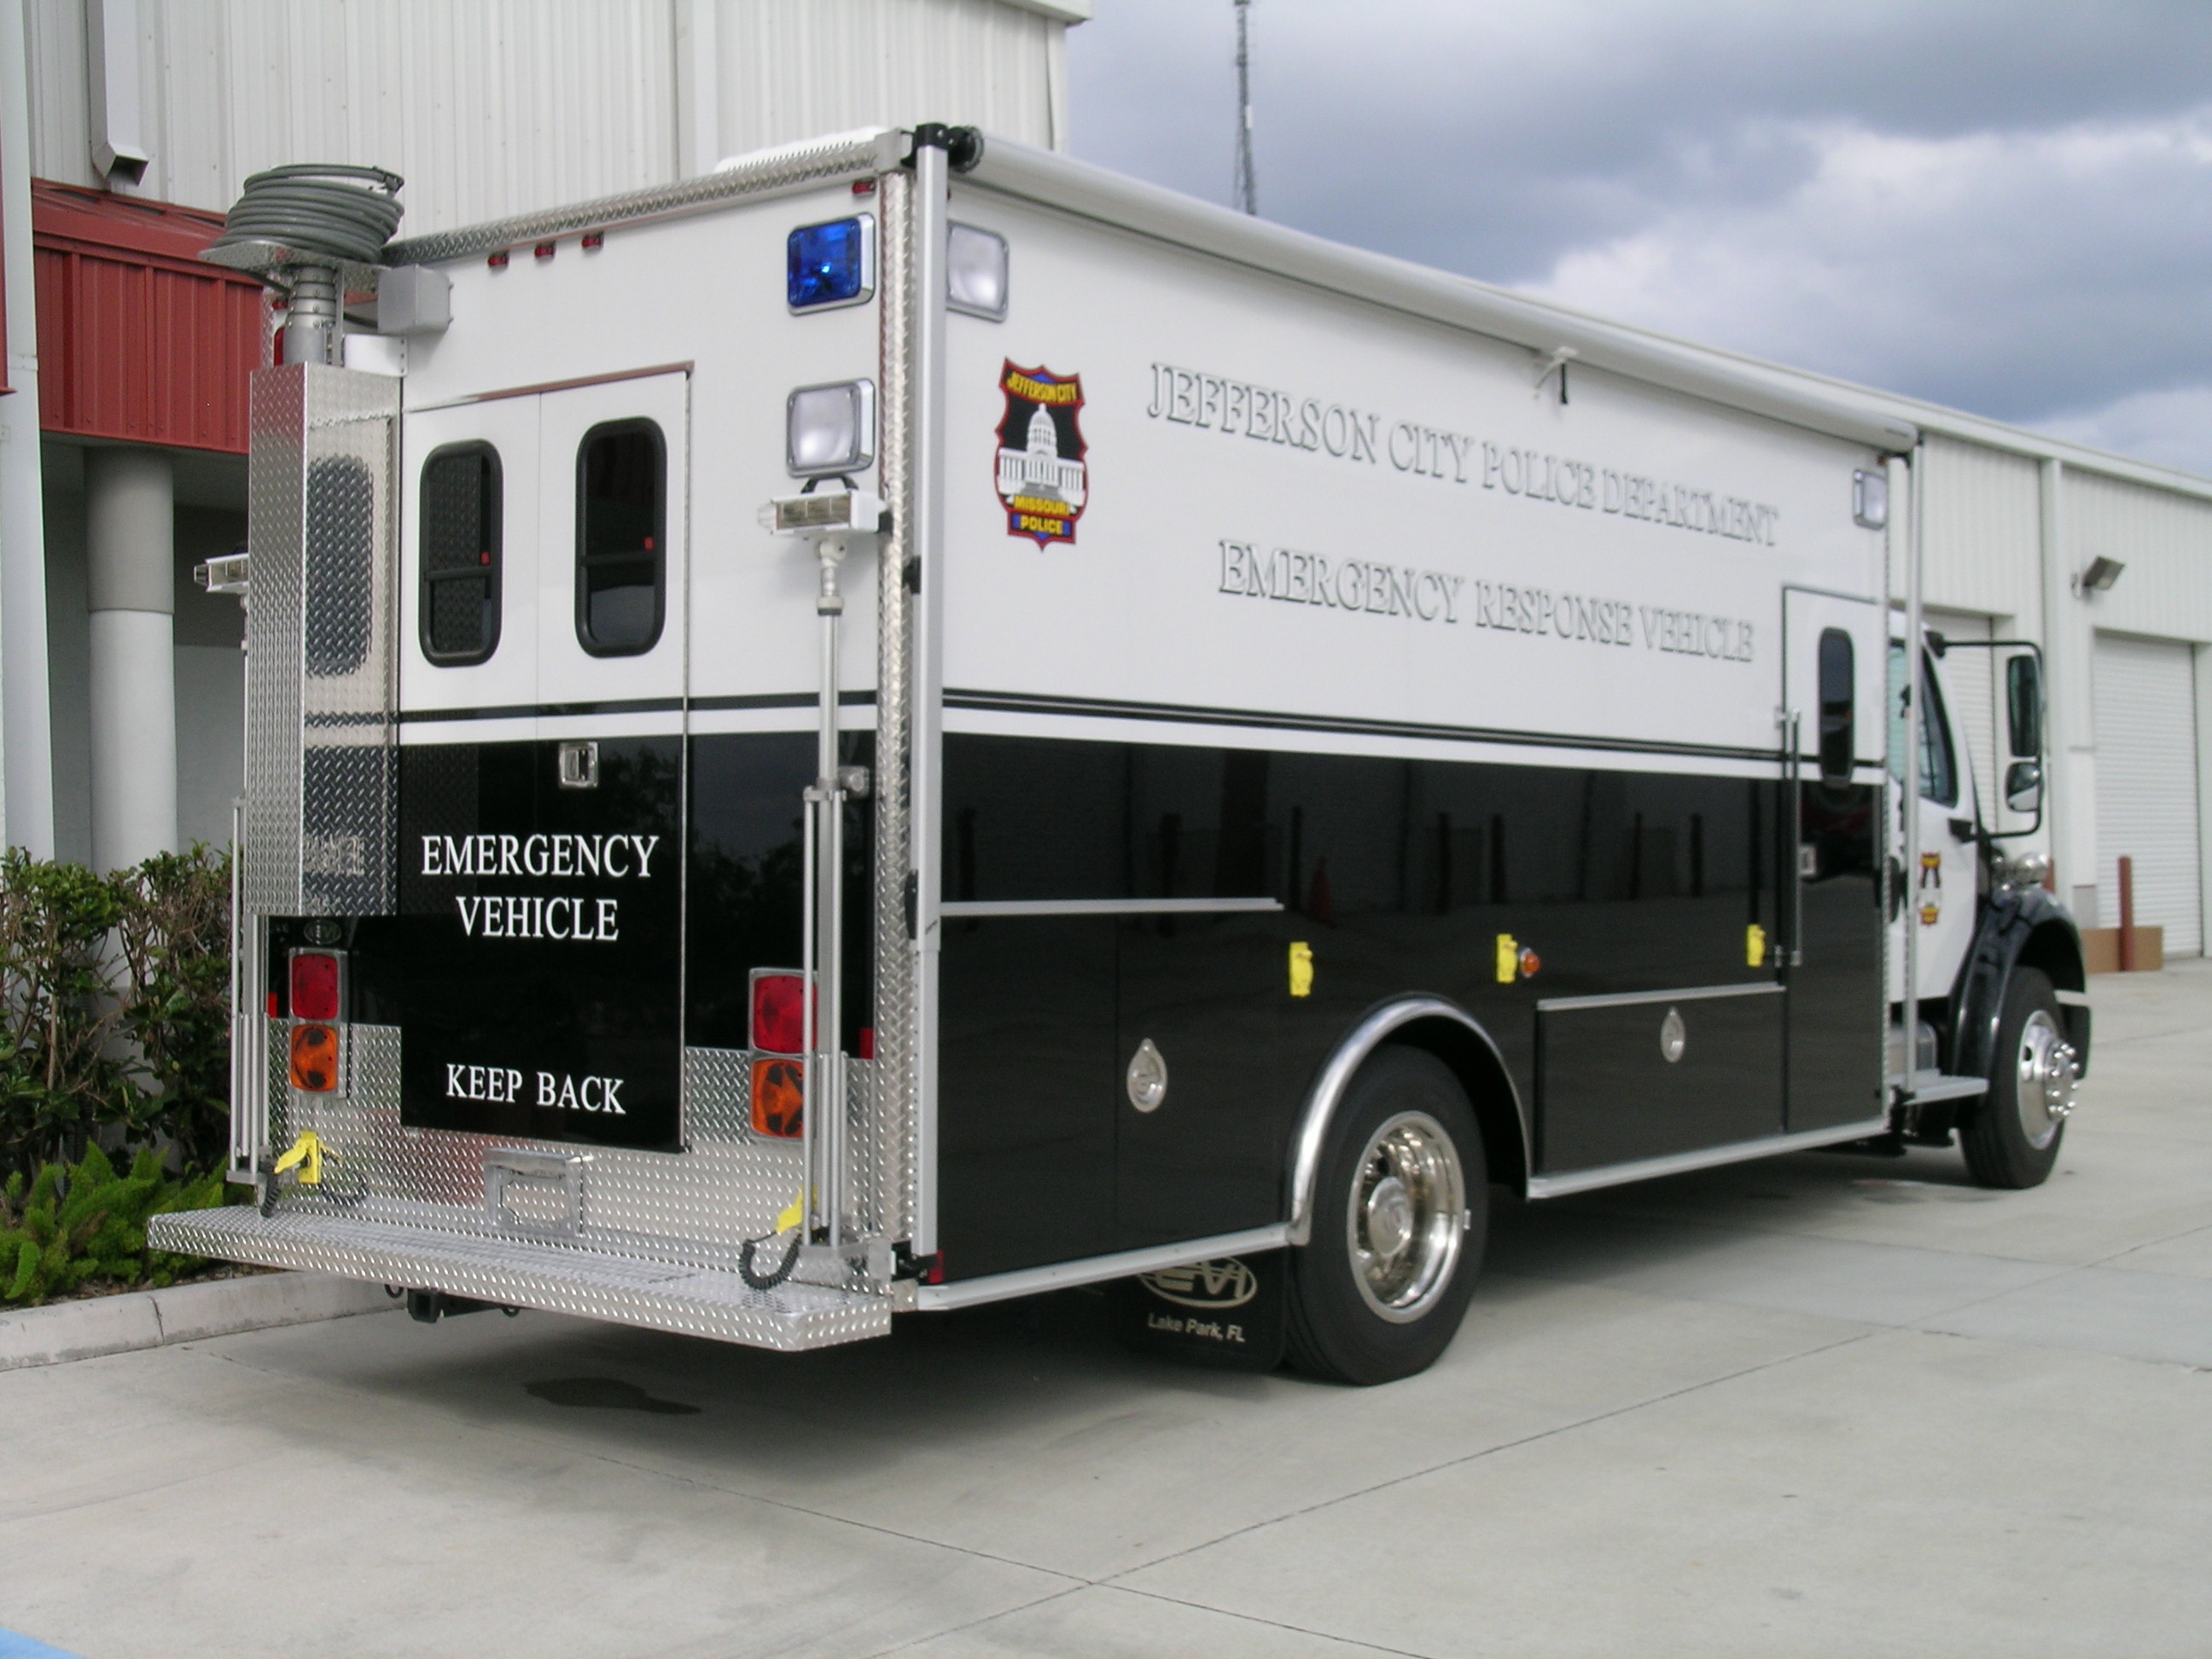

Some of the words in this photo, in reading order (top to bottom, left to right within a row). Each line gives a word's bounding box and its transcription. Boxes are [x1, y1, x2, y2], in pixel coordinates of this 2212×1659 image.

[1146, 362, 1380, 463] JEFFERSON
[1387, 422, 1473, 483] CITY
[1481, 442, 1594, 509] POLICE
[1601, 469, 1779, 546] DEPARTMENT
[1014, 496, 1069, 516] MISSOURI
[1020, 516, 1062, 535] POLICE
[1218, 539, 1464, 626] EMERGENCY
[1474, 580, 1633, 647] RESPONSE
[1639, 604, 1754, 662] VEHICLE
[422, 834, 660, 877] EMERGENCY
[456, 896, 620, 942] VEHICLE
[446, 1063, 523, 1103] KEEP
[537, 1072, 626, 1115] BACK
[1148, 1313, 1183, 1332] Lake
[1226, 1324, 1246, 1343] FL
